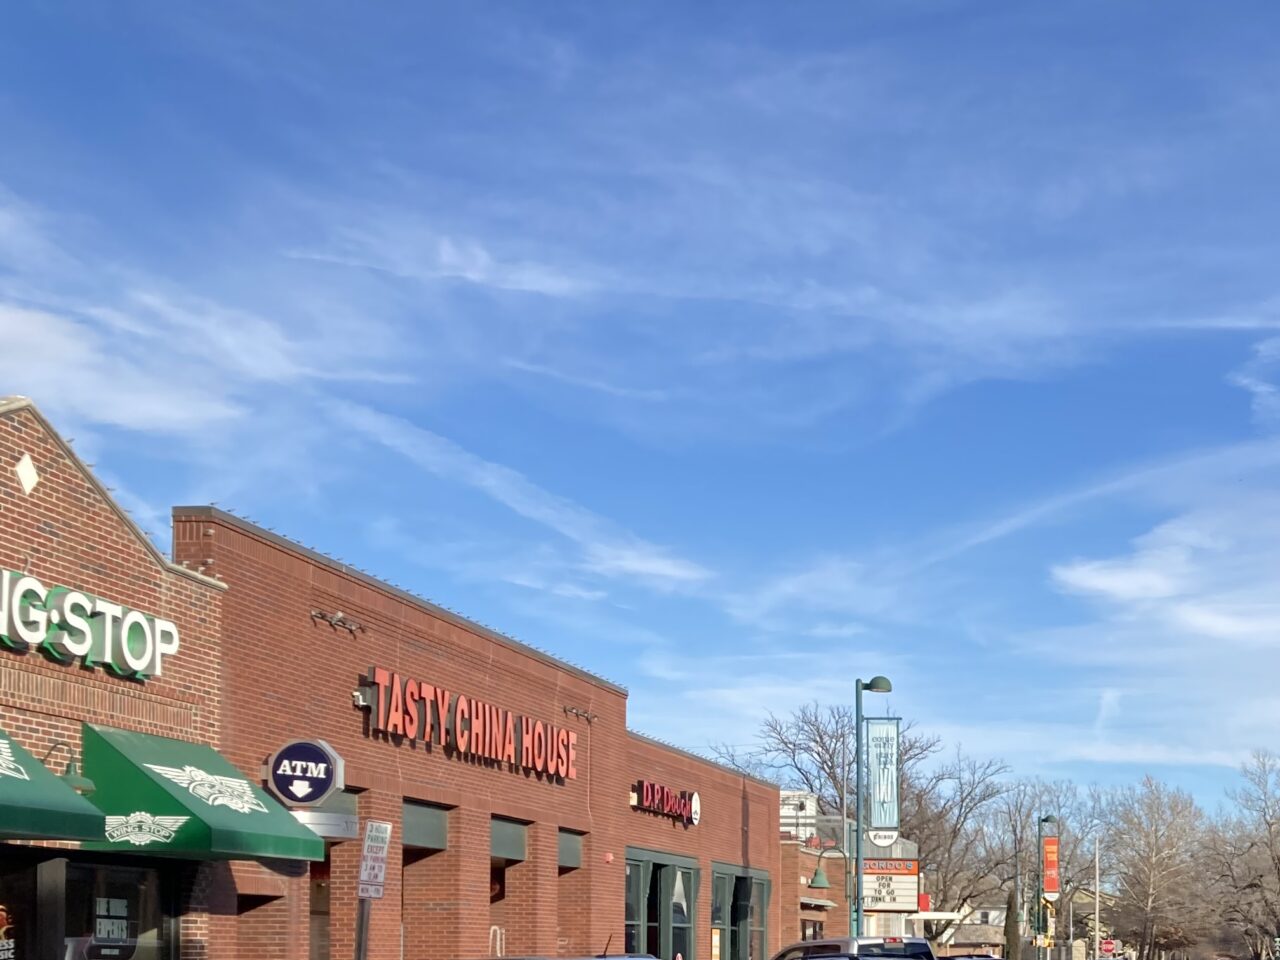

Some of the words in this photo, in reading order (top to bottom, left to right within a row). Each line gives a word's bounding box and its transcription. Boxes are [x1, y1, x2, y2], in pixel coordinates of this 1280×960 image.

[374, 667, 450, 745] TASTY
[455, 695, 515, 764] CHINA
[521, 715, 577, 779] HOUSE
[276, 760, 327, 779] ATM
[110, 825, 139, 838] WING
[142, 825, 170, 836] STOP
